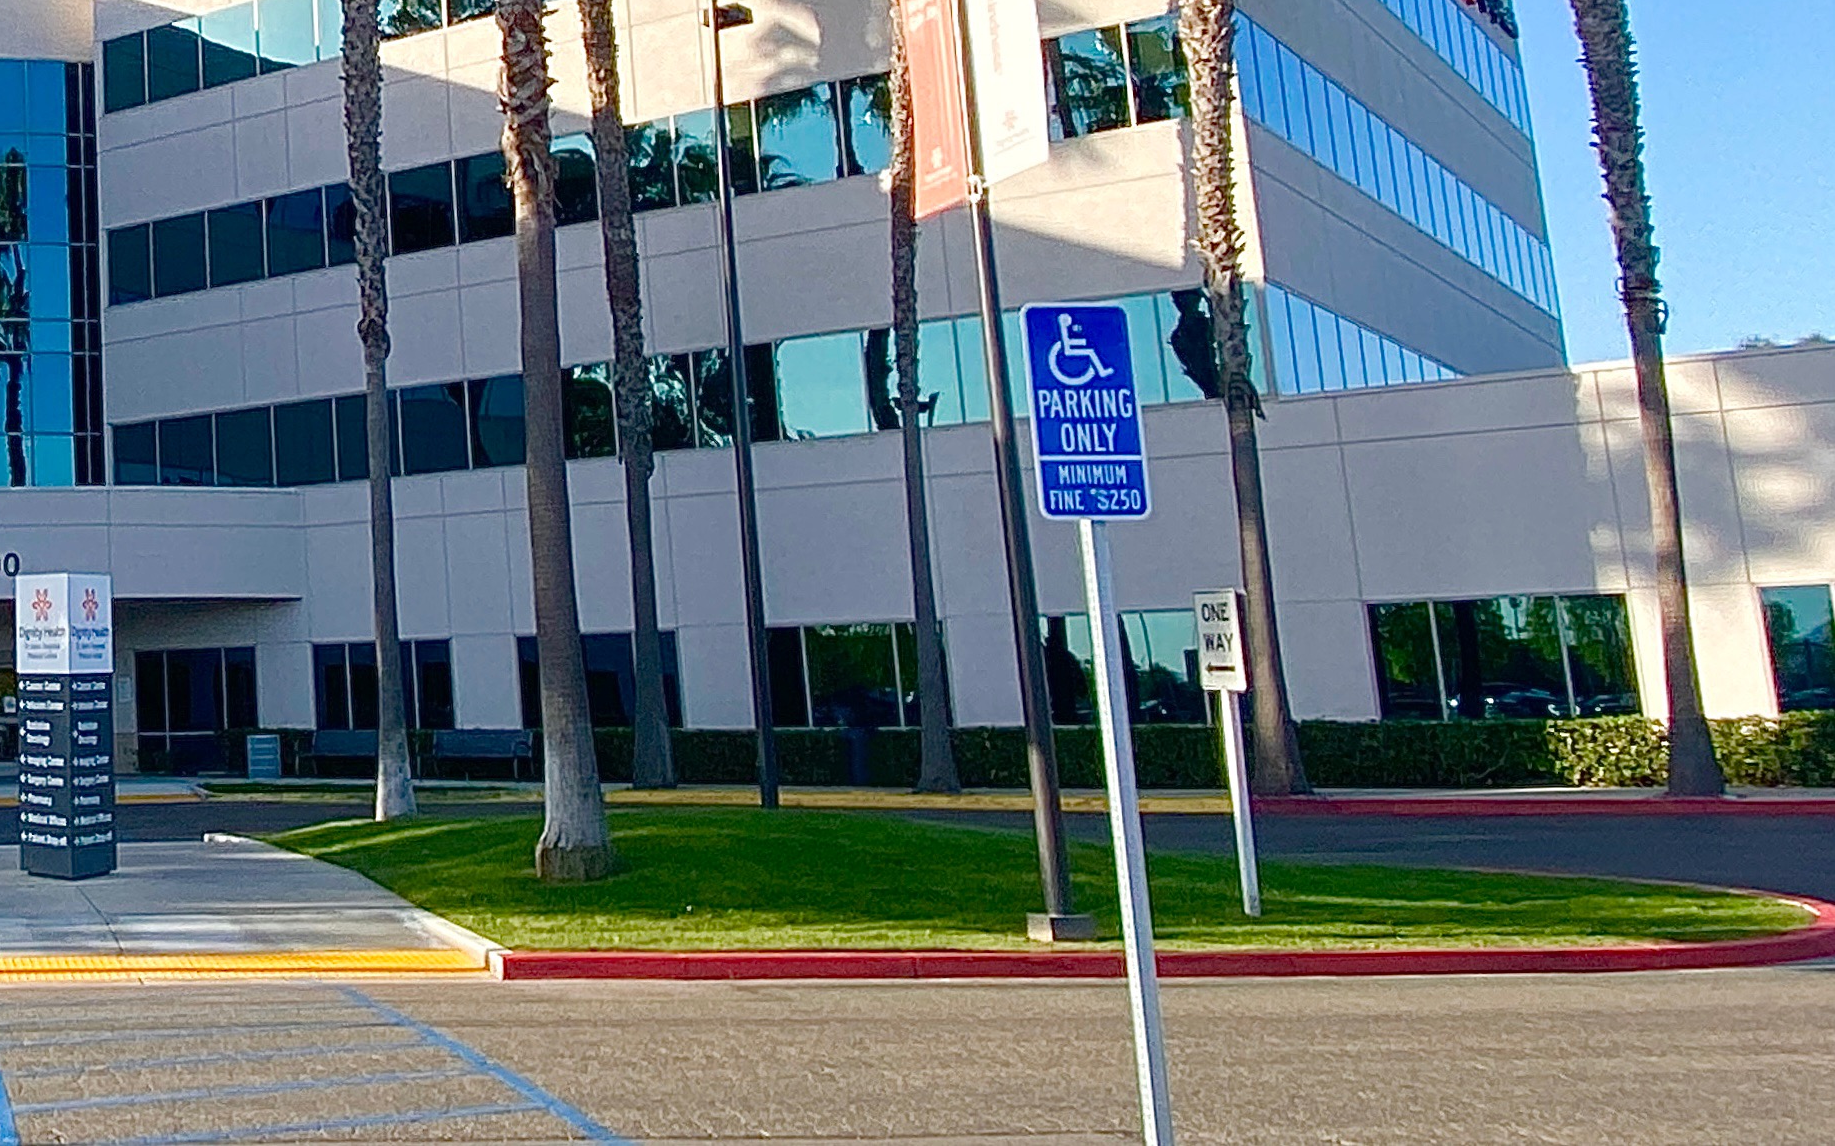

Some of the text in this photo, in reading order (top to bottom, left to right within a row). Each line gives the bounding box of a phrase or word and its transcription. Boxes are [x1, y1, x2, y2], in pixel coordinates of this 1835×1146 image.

[1038, 389, 1133, 419] PARKING
[1060, 423, 1117, 452] ONLY
[1058, 464, 1127, 485] MINIMUM
[1049, 489, 1084, 510] FINE
[1201, 602, 1230, 622] ONE
[1203, 633, 1233, 652] WAY
